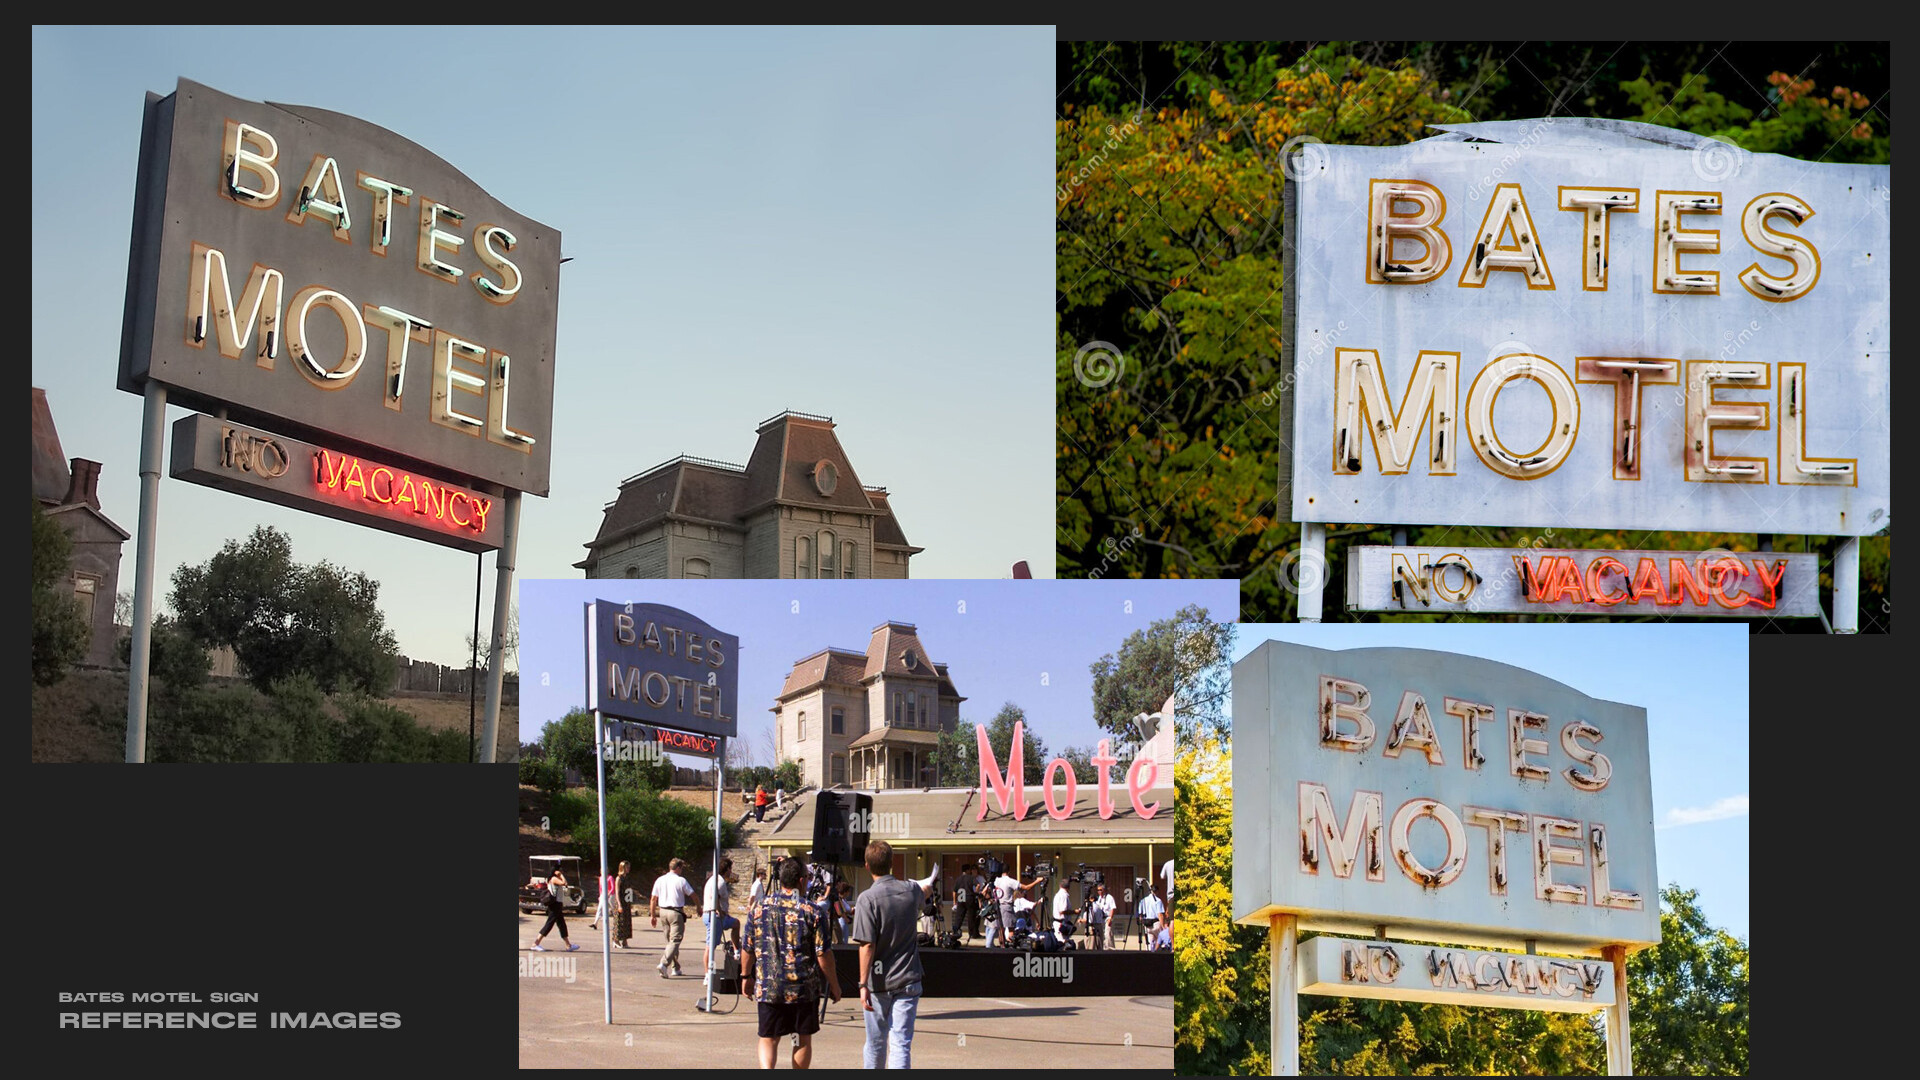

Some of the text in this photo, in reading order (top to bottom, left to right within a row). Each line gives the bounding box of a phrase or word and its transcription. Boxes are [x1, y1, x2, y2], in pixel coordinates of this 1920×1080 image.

[218, 118, 523, 305] BATES
[1365, 178, 1822, 303] BATES
[184, 240, 536, 455] MOTEL
[1332, 347, 1859, 488] MOTEL
[220, 426, 492, 533] NO VACANCY
[1391, 552, 1789, 610] NO VACANCY
[607, 661, 732, 722] MOTEL
[614, 613, 725, 668] BATES
[656, 729, 717, 753] VACANCY
[1319, 675, 1614, 793] BATES
[1298, 780, 1644, 909] MOTEL
[1341, 941, 1604, 1000] NO VACANCY
